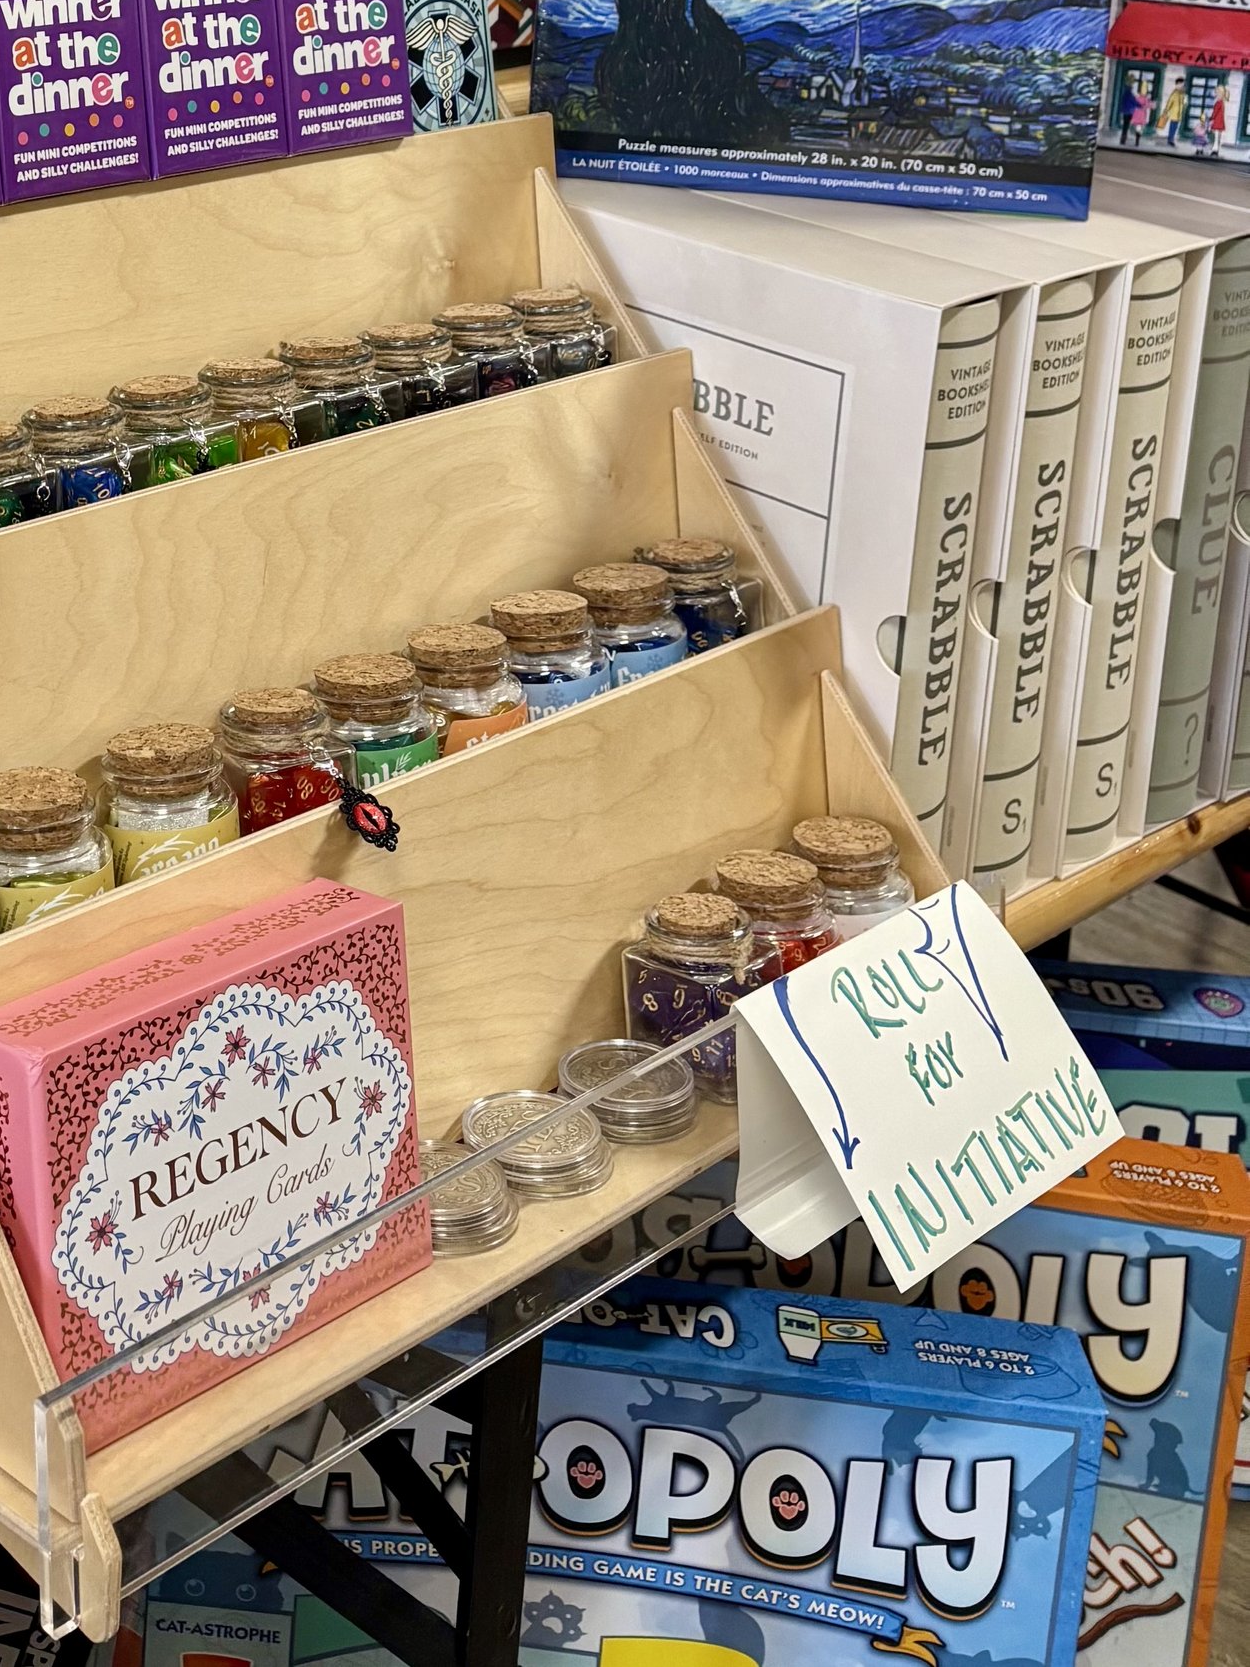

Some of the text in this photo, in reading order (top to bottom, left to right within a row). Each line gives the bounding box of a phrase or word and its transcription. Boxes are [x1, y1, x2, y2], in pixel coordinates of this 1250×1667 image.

[1110, 42, 1231, 66] HISTORY ART
[617, 138, 809, 166] Puzzle measures approximately
[1044, 331, 1085, 352] VINTAGE
[950, 359, 992, 381] VINTAGE
[1041, 369, 1080, 390] EDITION
[947, 400, 987, 420] EDITION
[1191, 444, 1236, 616] CLUE
[1106, 434, 1159, 692] SCRABBLE
[1012, 459, 1067, 725] SCRABBLE
[917, 492, 973, 767] SCRABBLE
[128, 1075, 347, 1221] REGENCY
[867, 1055, 1107, 1272] INITIATIVE
[154, 1154, 336, 1264] Playing Cards
[917, 1351, 982, 1369] PLAYERS
[593, 1559, 885, 1631] GAME IS THE CAT'S MEOW!
[154, 1617, 282, 1645] CAT-ASTROPHE
